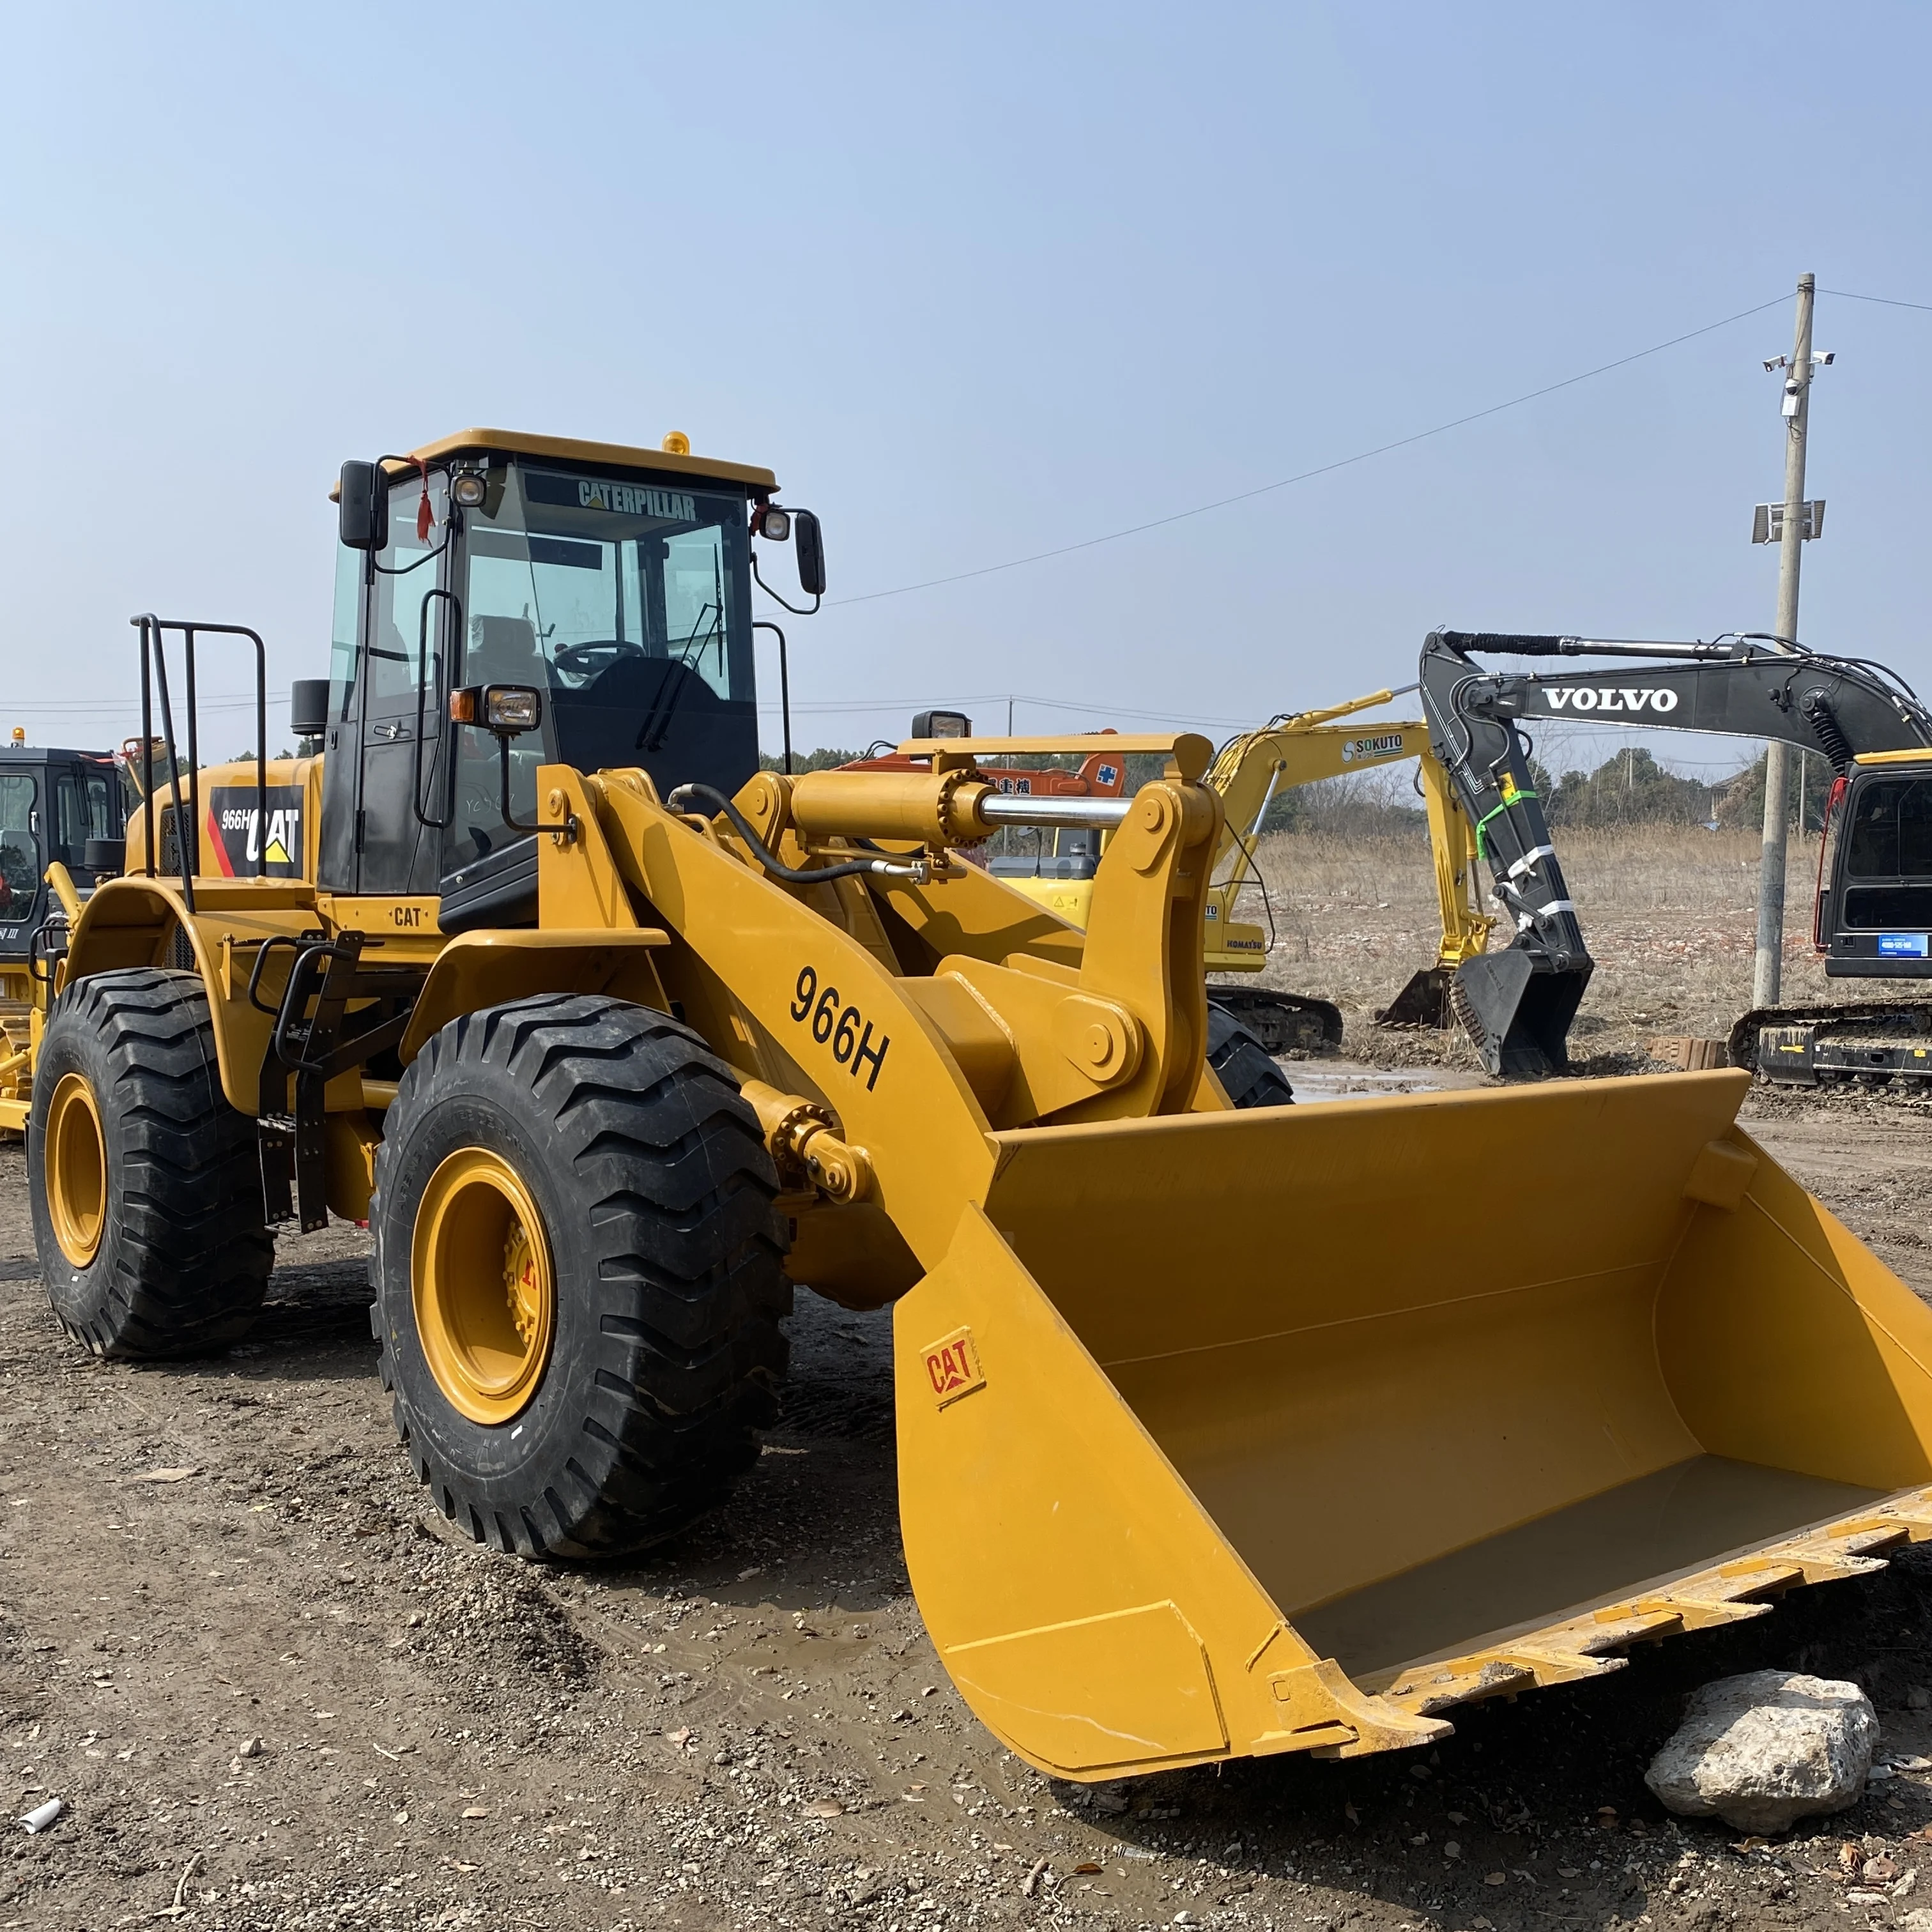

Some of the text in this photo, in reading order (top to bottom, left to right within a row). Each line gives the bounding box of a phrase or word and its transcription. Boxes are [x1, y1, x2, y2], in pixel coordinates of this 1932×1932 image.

[578, 480, 696, 522] CATERPILLAR
[1542, 687, 1678, 712] VOLVO
[1356, 734, 1402, 753] SOKUTO
[222, 809, 251, 830] 966H
[247, 808, 299, 862] CAT
[394, 907, 421, 927] CAT
[1227, 939, 1262, 950] KOMATSU
[790, 965, 891, 1093] 966H
[926, 1339, 971, 1394] CAT
